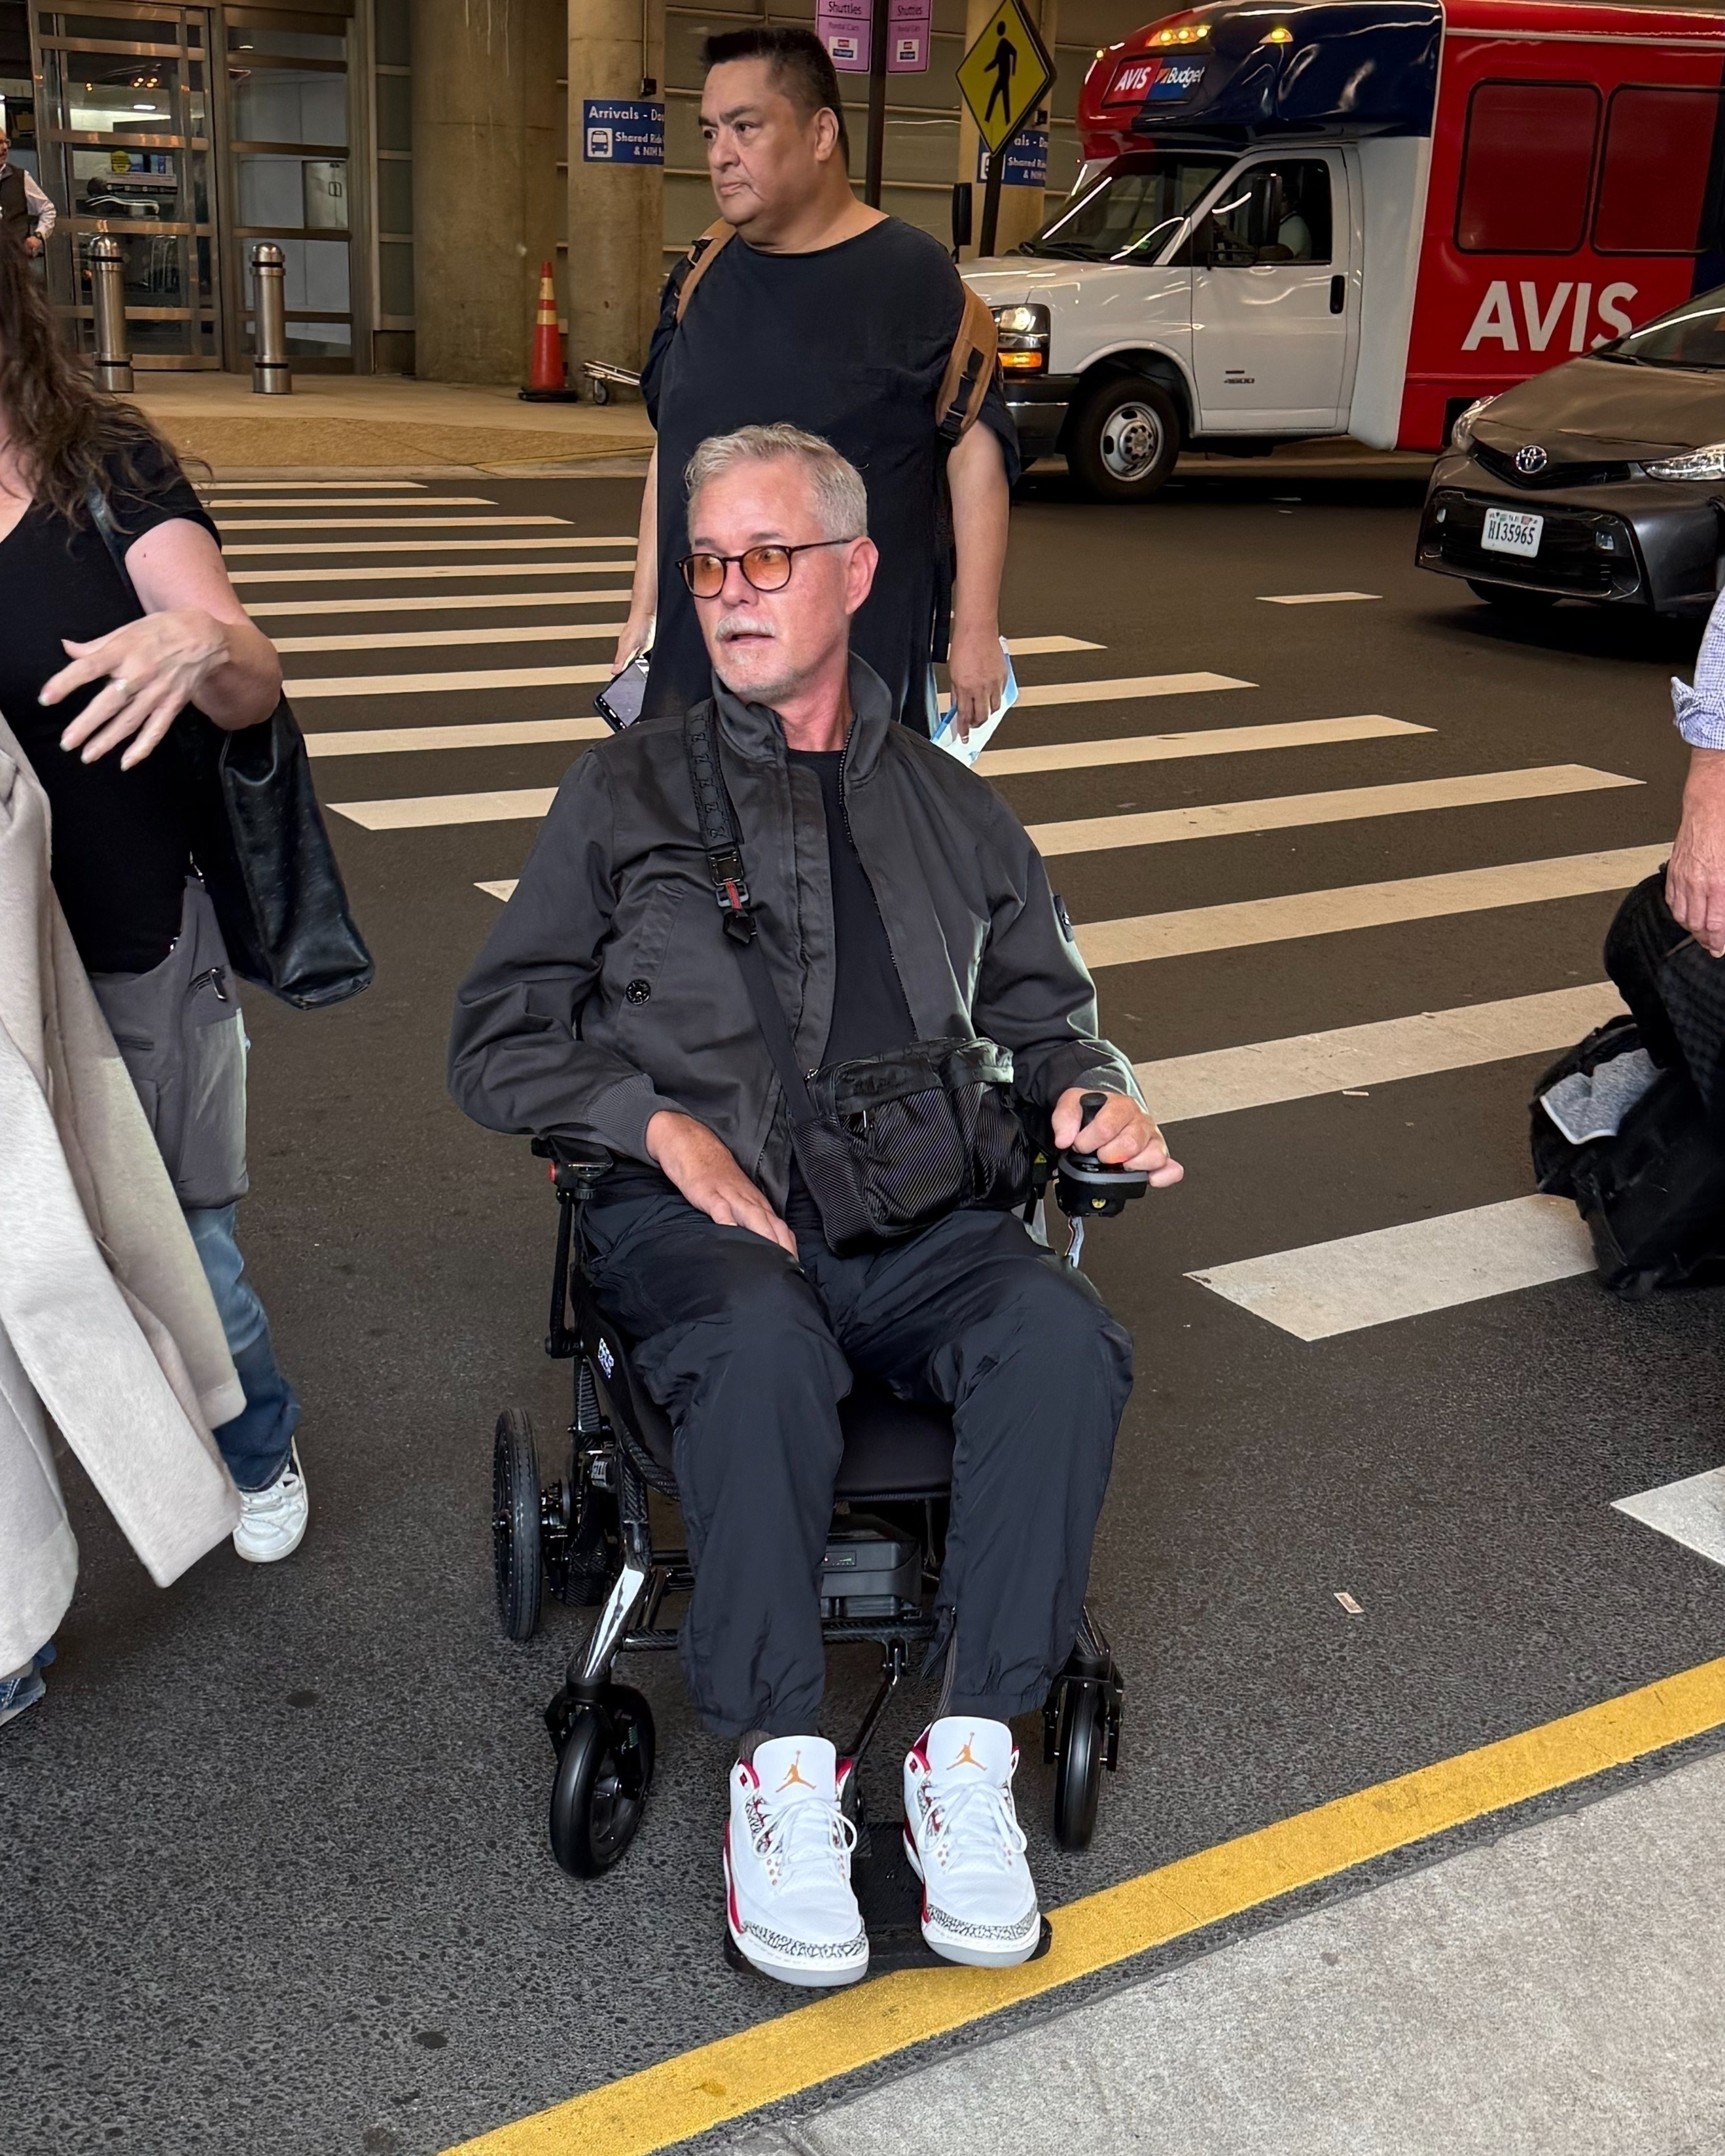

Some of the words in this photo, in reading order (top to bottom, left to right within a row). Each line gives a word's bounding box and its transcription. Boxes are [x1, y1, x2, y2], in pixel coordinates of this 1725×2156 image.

[829, 1, 862, 15] Shuttles
[1114, 66, 1152, 92] AVIS
[1167, 66, 1205, 88] Budget
[588, 105, 639, 120] Arrivals
[615, 131, 648, 143] Shared
[633, 145, 641, 155] &
[1460, 280, 1639, 352] AVIS
